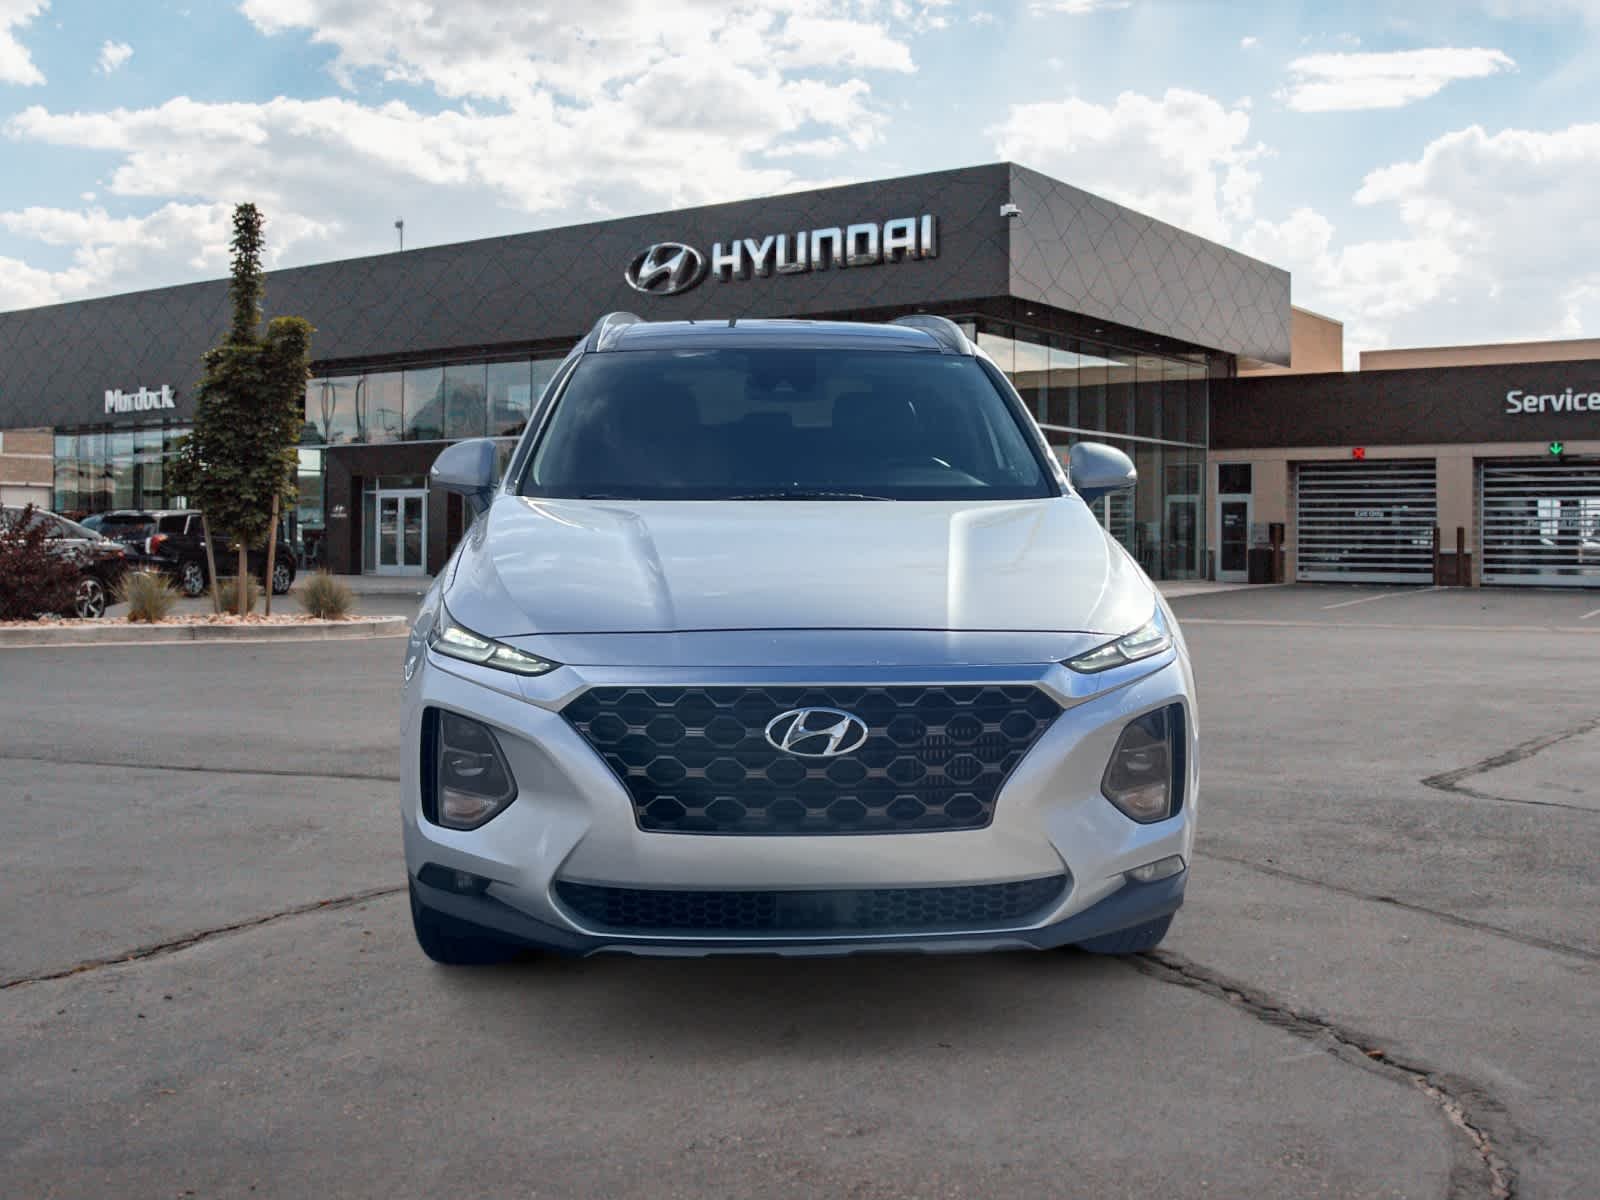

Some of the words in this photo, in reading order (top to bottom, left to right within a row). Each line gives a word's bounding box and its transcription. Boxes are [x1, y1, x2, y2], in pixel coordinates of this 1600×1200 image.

[712, 214, 934, 280] HYUNDAI
[105, 384, 176, 414] Murdock
[1506, 387, 1600, 414] Service
